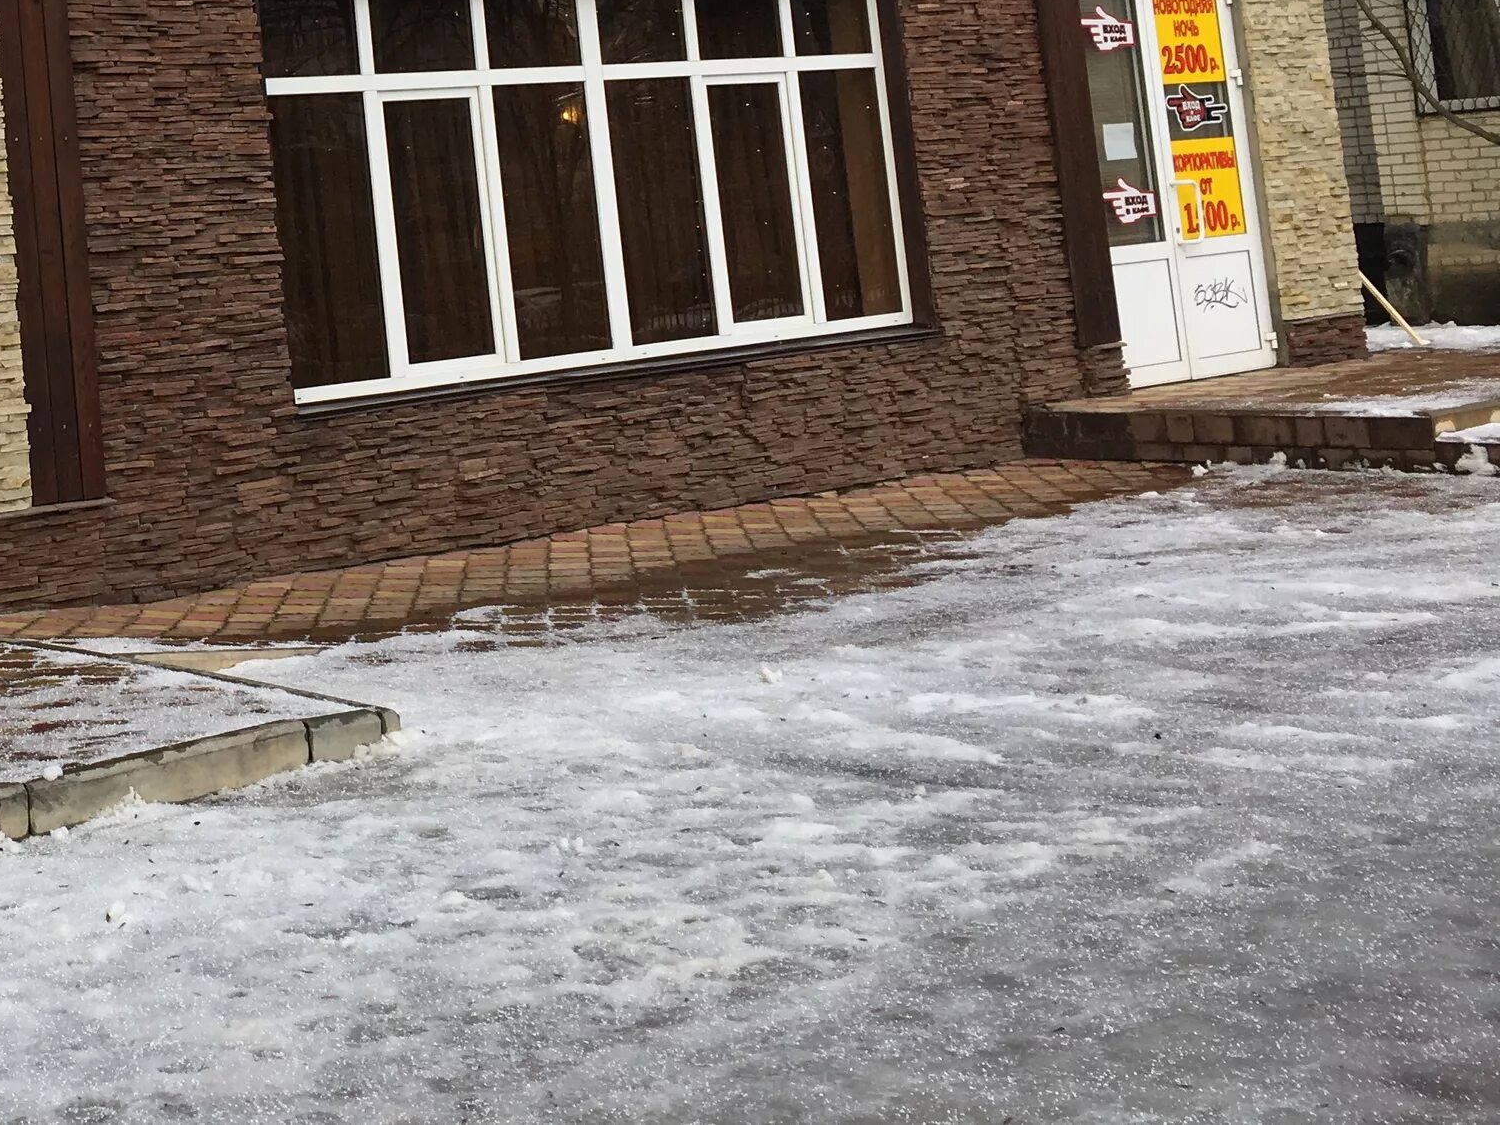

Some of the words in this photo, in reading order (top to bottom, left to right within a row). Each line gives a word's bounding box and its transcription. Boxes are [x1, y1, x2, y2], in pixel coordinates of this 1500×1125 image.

[1103, 24, 1126, 35] ВХОД
[1173, 20, 1200, 37] НОЧЬ
[1161, 43, 1208, 75] 2500
[1172, 150, 1236, 173] КОРПОРАТИВЫ
[1199, 177, 1213, 196] ОТ
[1124, 195, 1149, 207] ВХОД
